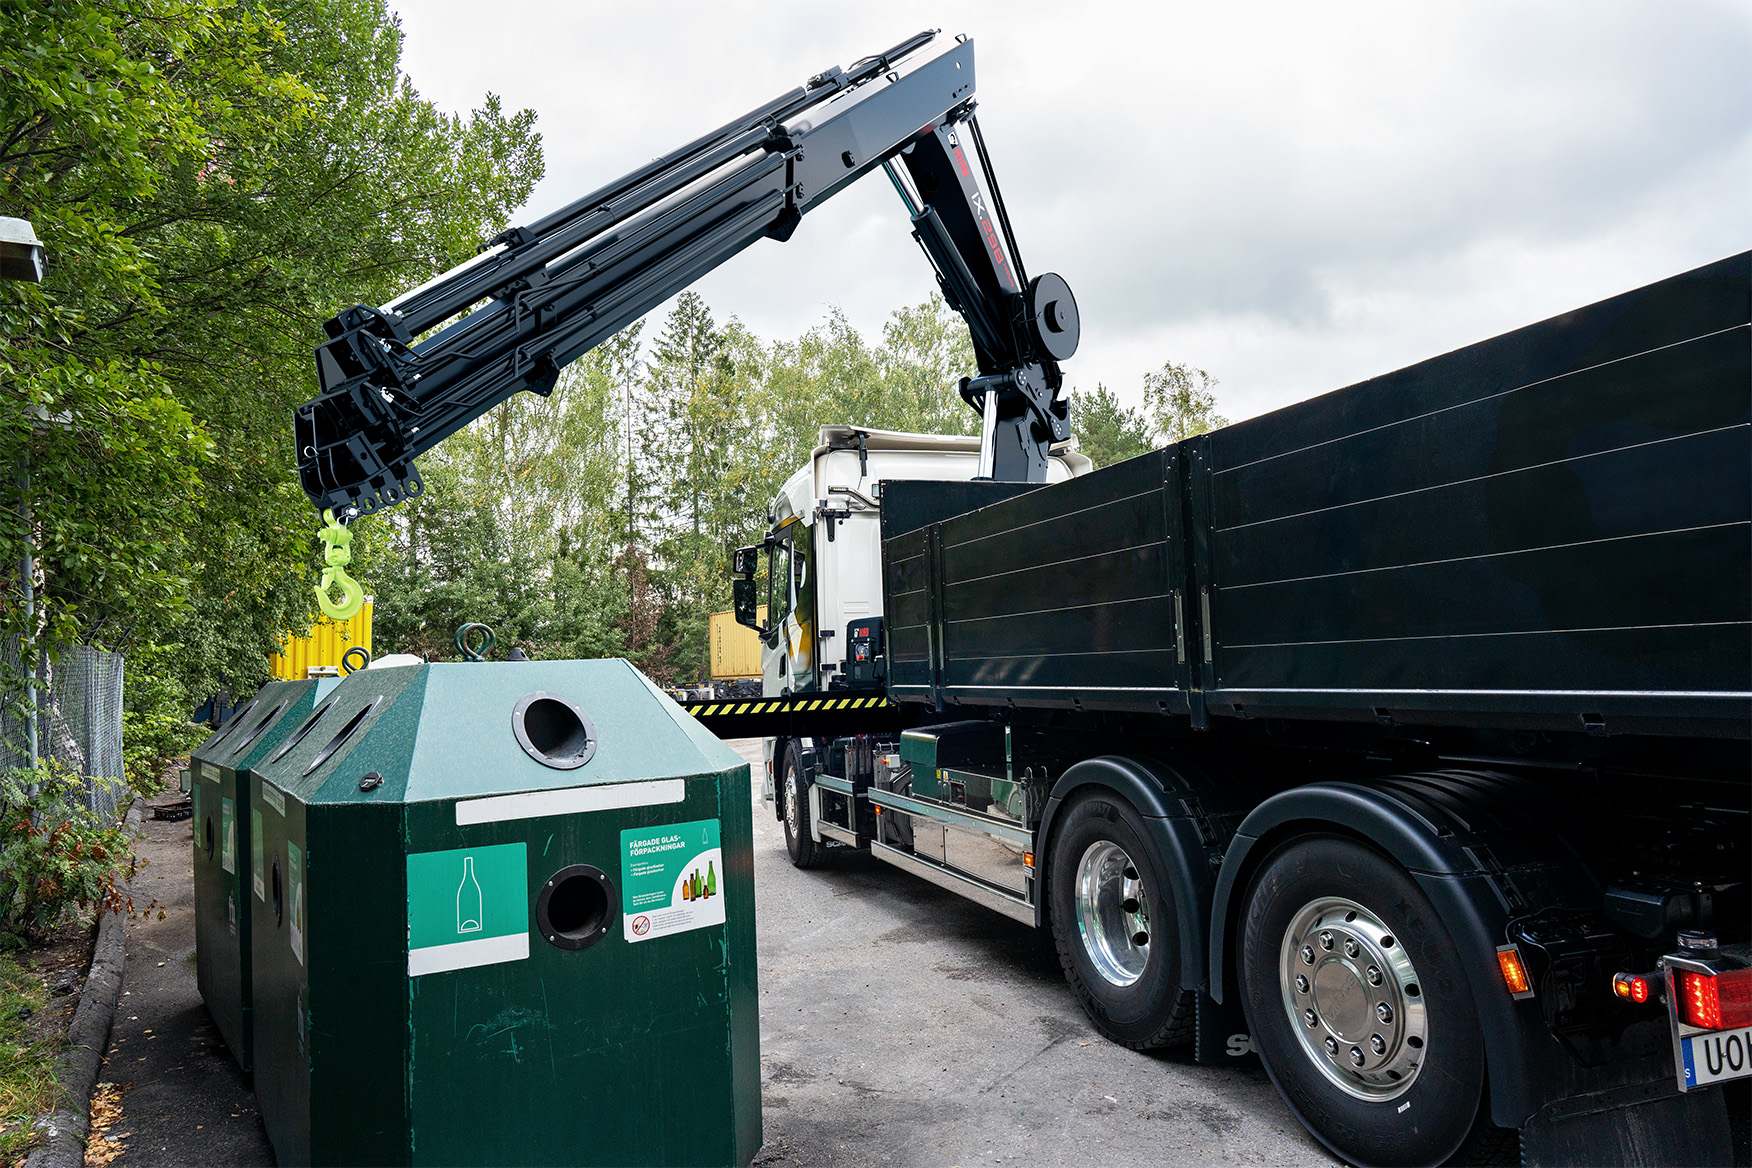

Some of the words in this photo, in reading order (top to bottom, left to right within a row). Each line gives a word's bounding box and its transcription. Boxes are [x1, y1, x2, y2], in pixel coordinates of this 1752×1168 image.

[953, 147, 970, 178] HIAB
[629, 838, 660, 849] FÄRGADE
[661, 835, 681, 845] GLAS-
[630, 842, 686, 856] FÖRPACKNINGAR
